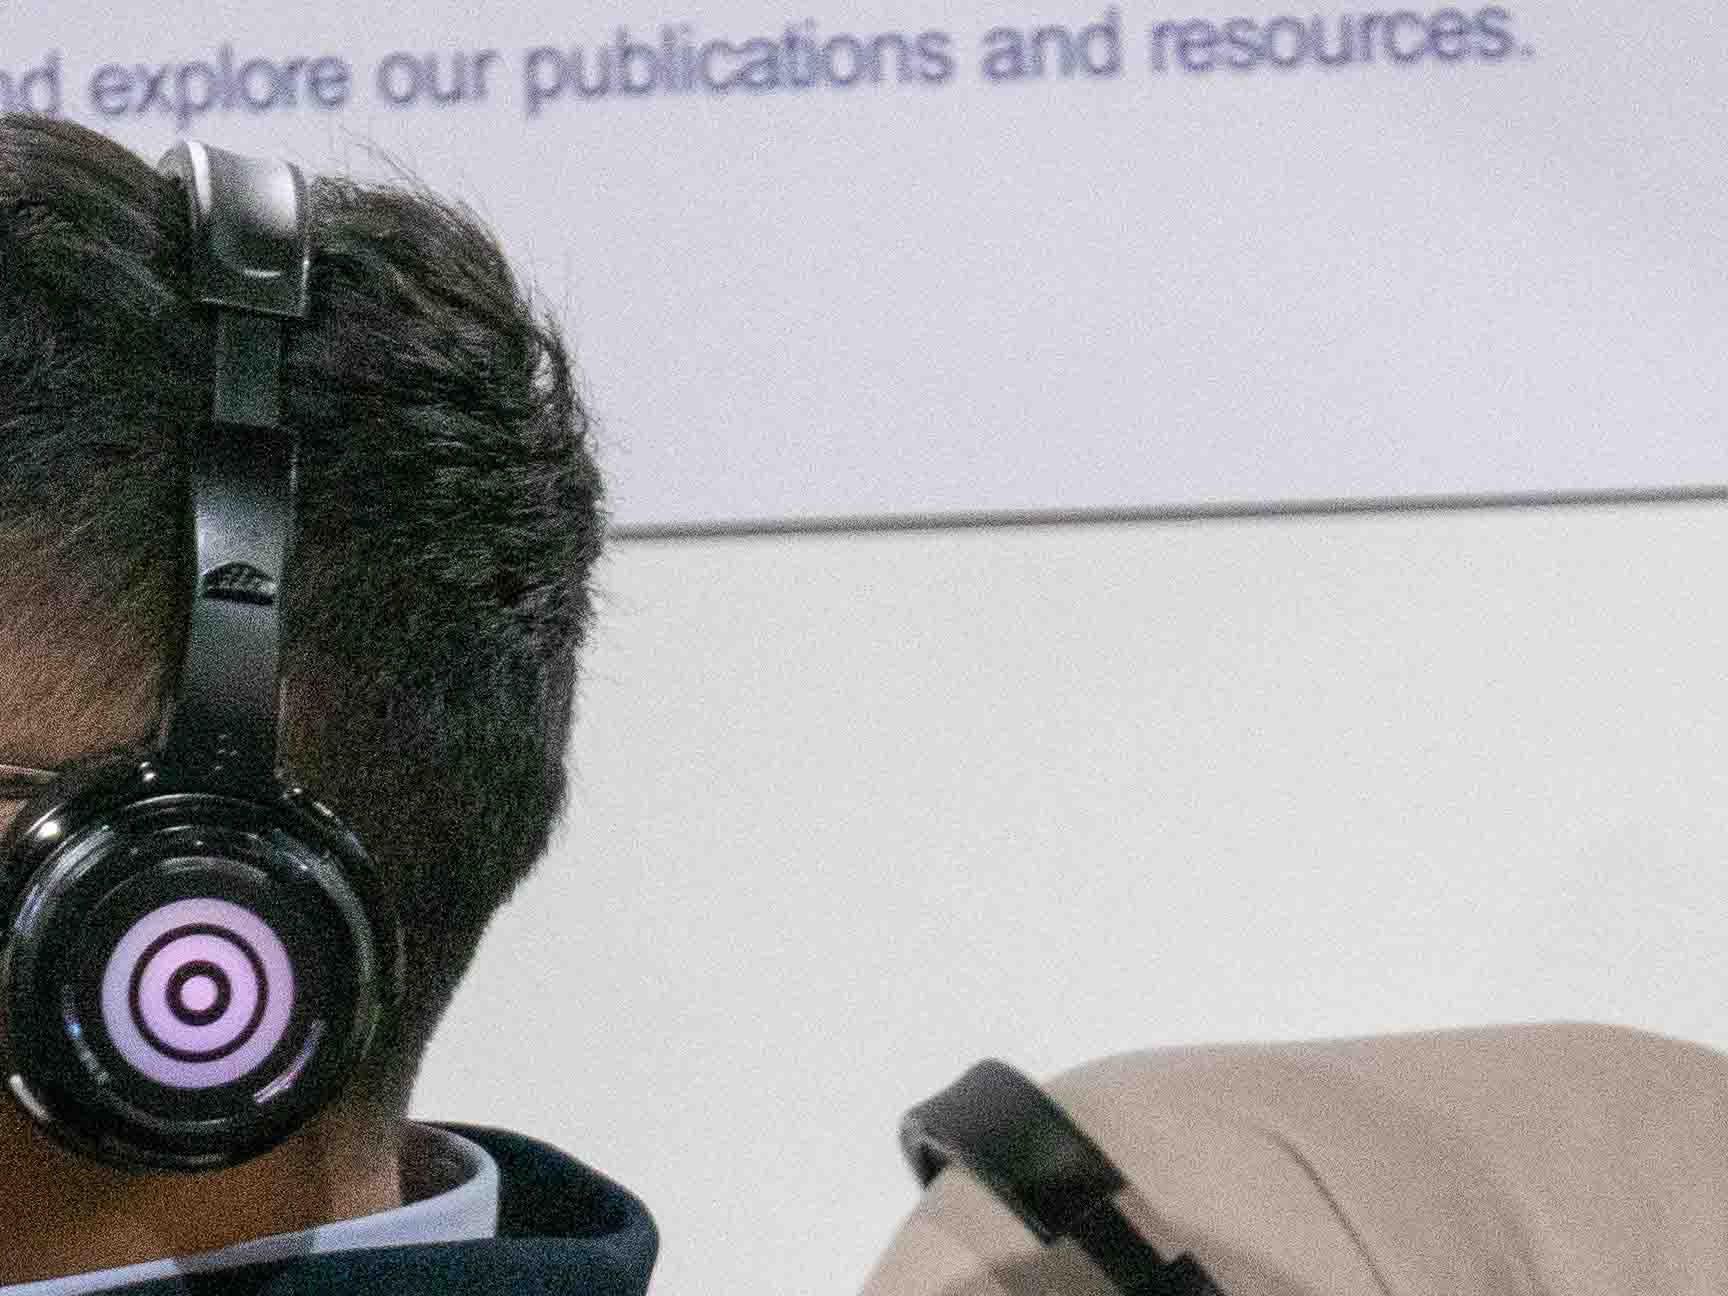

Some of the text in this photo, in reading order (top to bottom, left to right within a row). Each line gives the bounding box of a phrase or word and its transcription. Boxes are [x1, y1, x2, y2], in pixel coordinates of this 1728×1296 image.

[86, 44, 353, 130] explore
[374, 48, 500, 109] our
[522, 18, 956, 118] publications
[980, 6, 1123, 83] and
[1149, 4, 1535, 73] resources.
